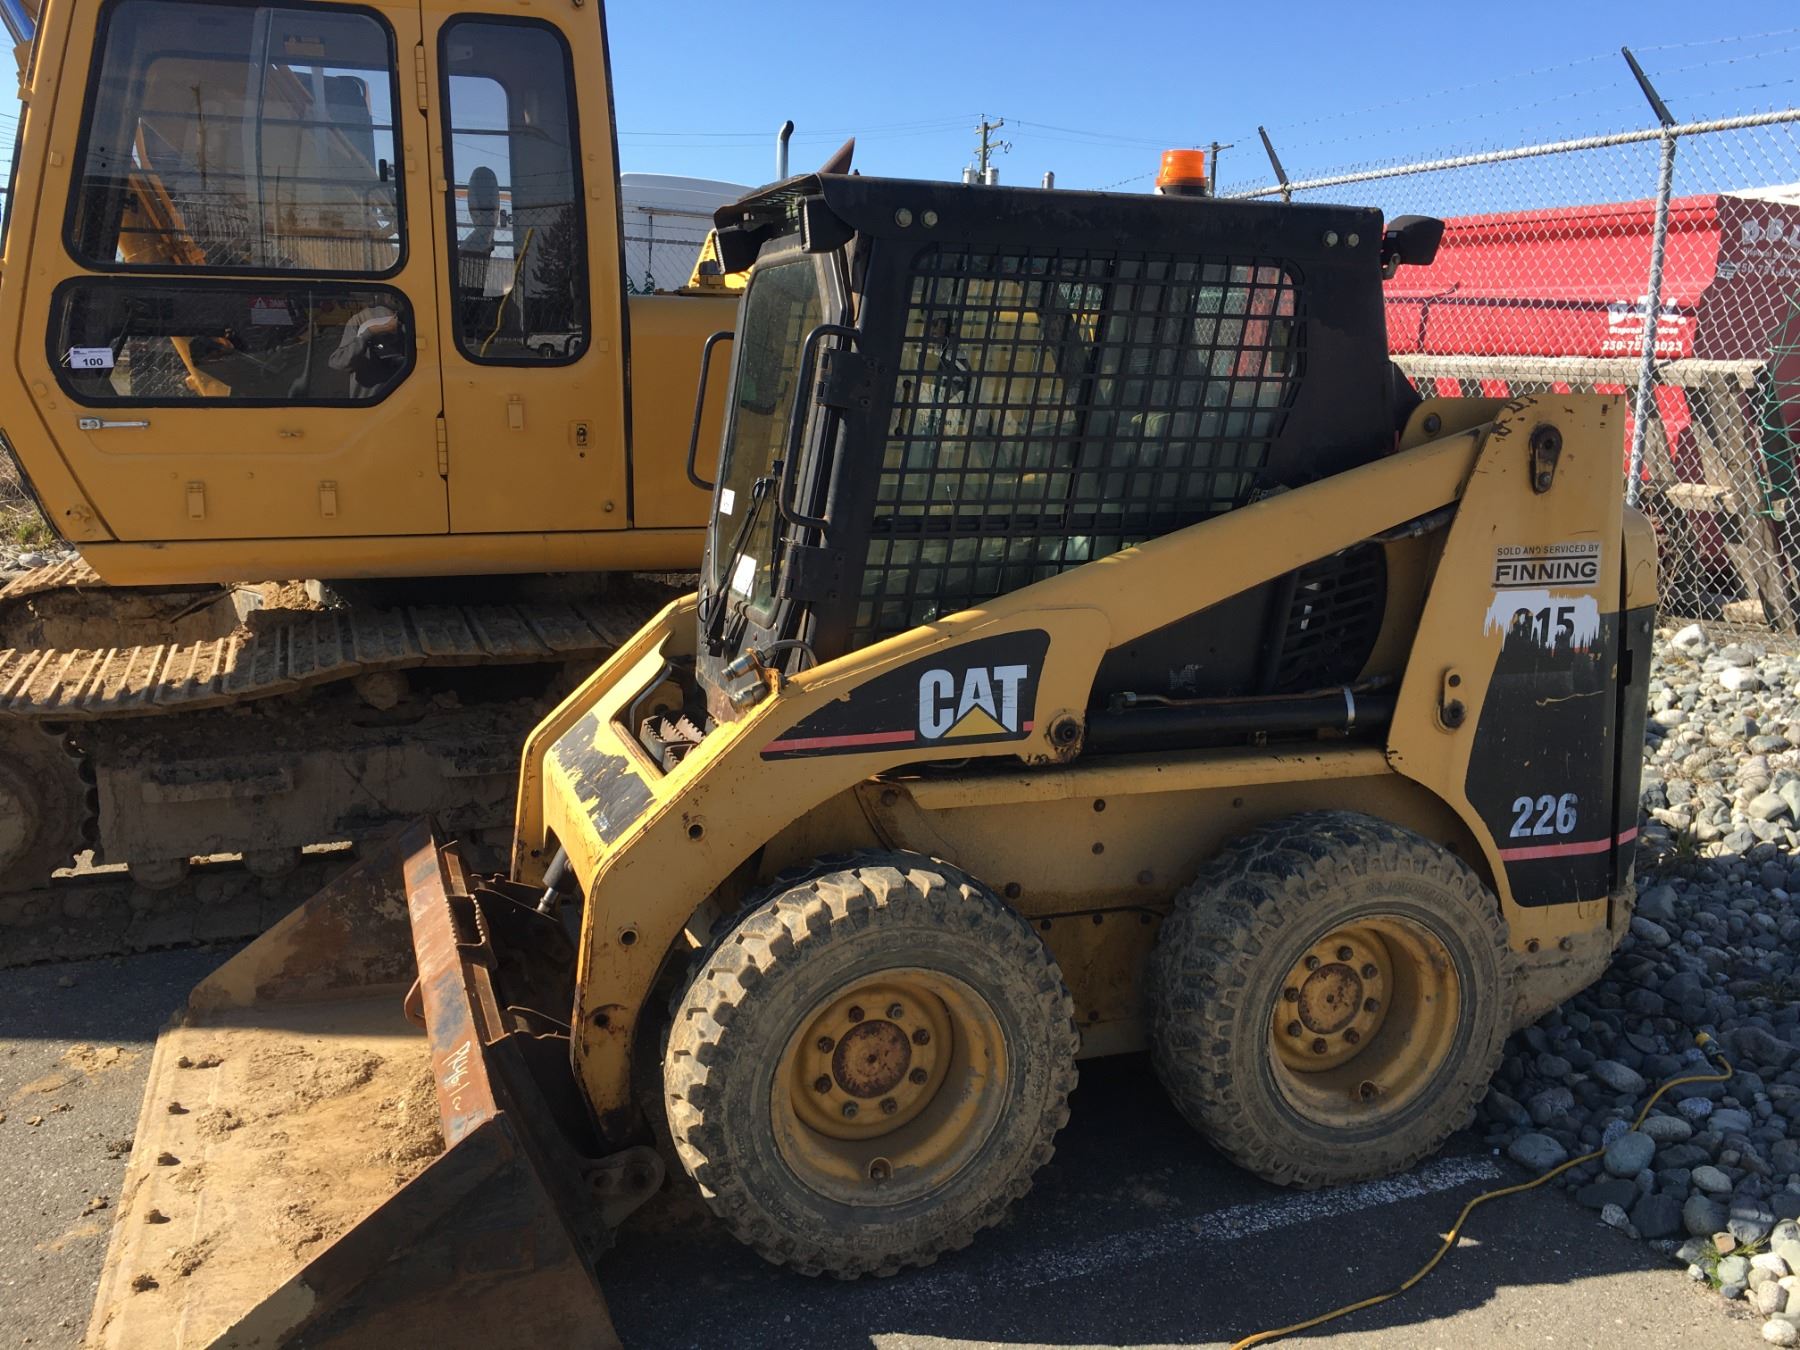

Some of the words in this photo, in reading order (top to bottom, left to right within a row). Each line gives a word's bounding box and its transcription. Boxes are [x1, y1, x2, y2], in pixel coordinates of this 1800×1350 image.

[83, 358, 104, 366] 100
[1497, 547, 1521, 556] SOLD
[1523, 546, 1541, 555] AND
[1544, 544, 1586, 554] SERVICED
[1588, 544, 1600, 552] BY
[1495, 562, 1597, 582] FINNING
[919, 664, 1028, 739] CAT
[1509, 793, 1578, 838] 226
